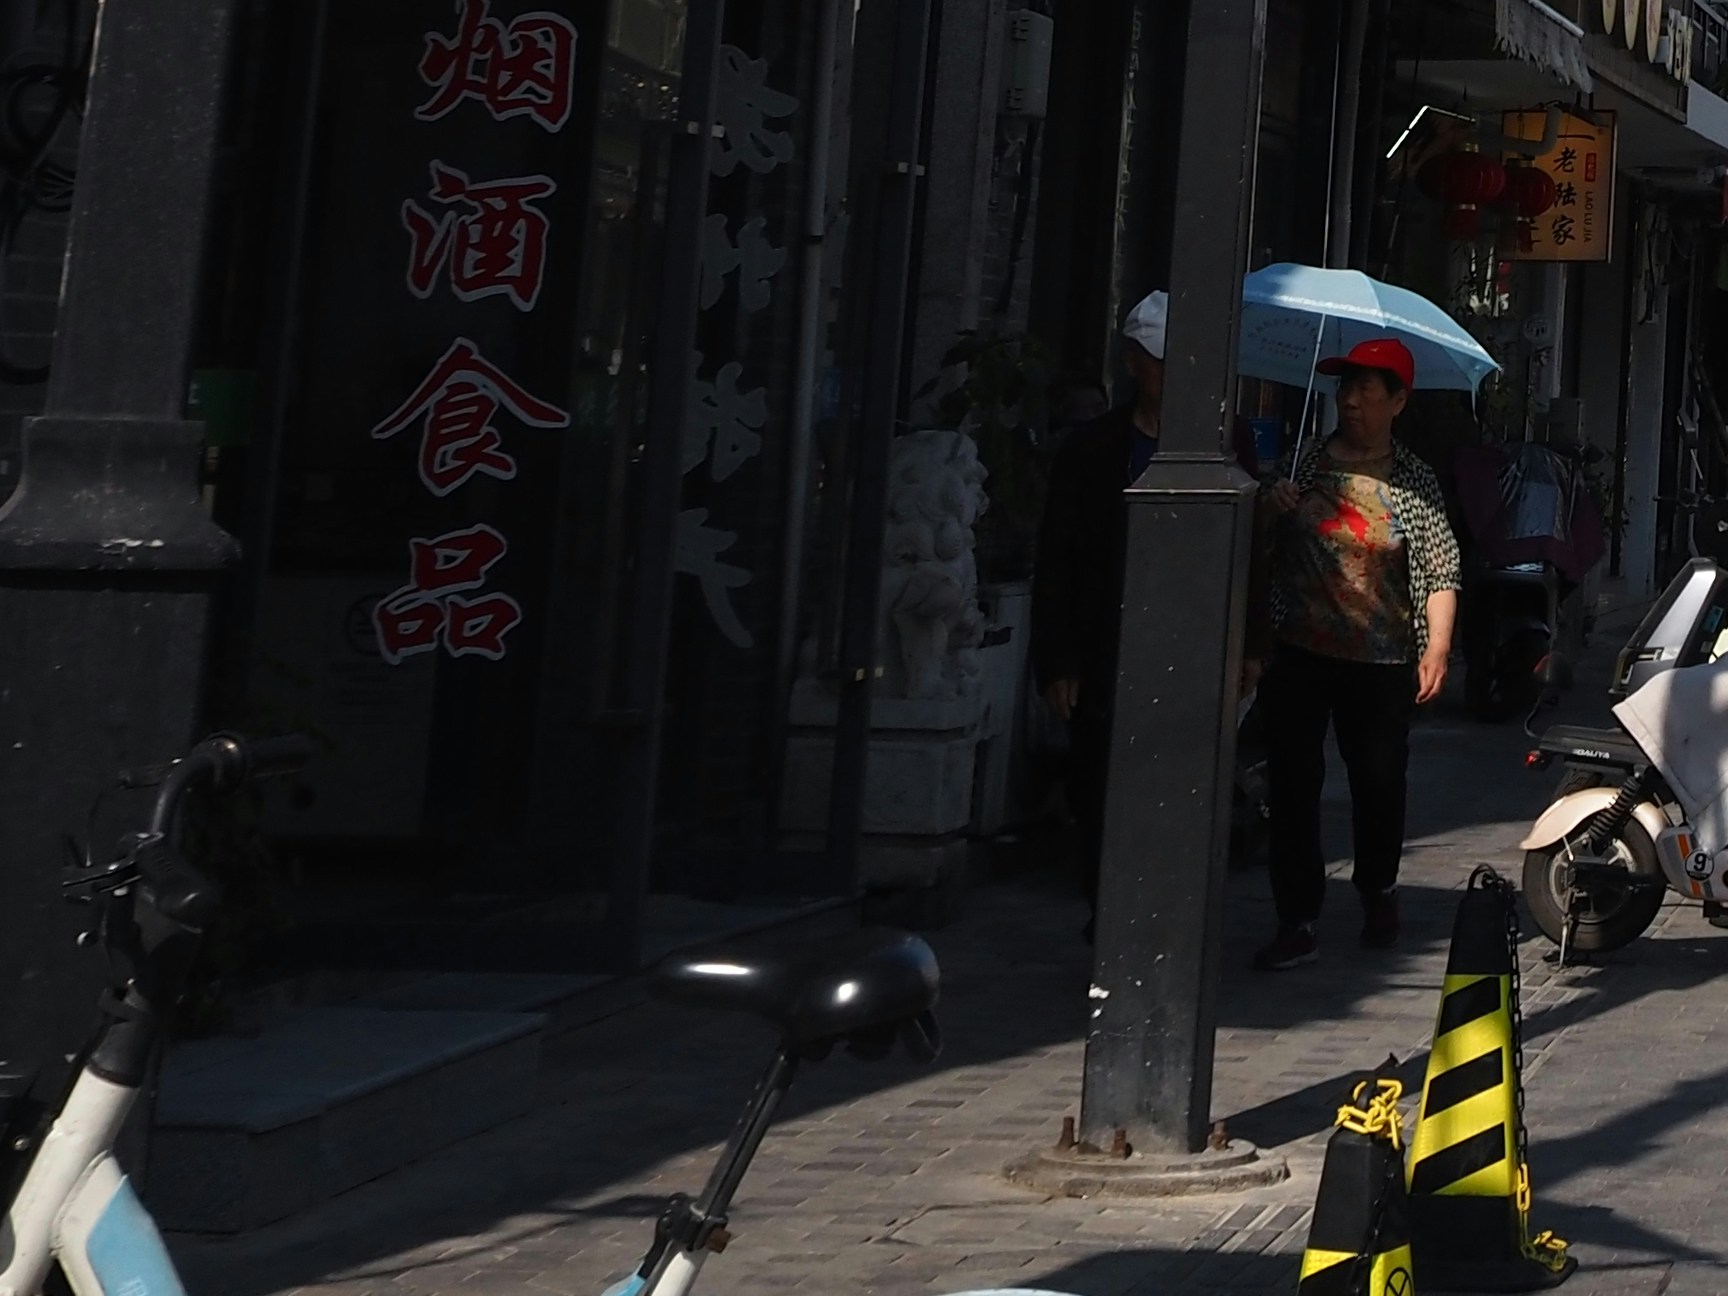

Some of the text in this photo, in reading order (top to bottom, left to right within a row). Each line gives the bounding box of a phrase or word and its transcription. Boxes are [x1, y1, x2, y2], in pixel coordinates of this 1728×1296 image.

[1551, 145, 1579, 246] 老陆家
[1693, 853, 1707, 873] 9
